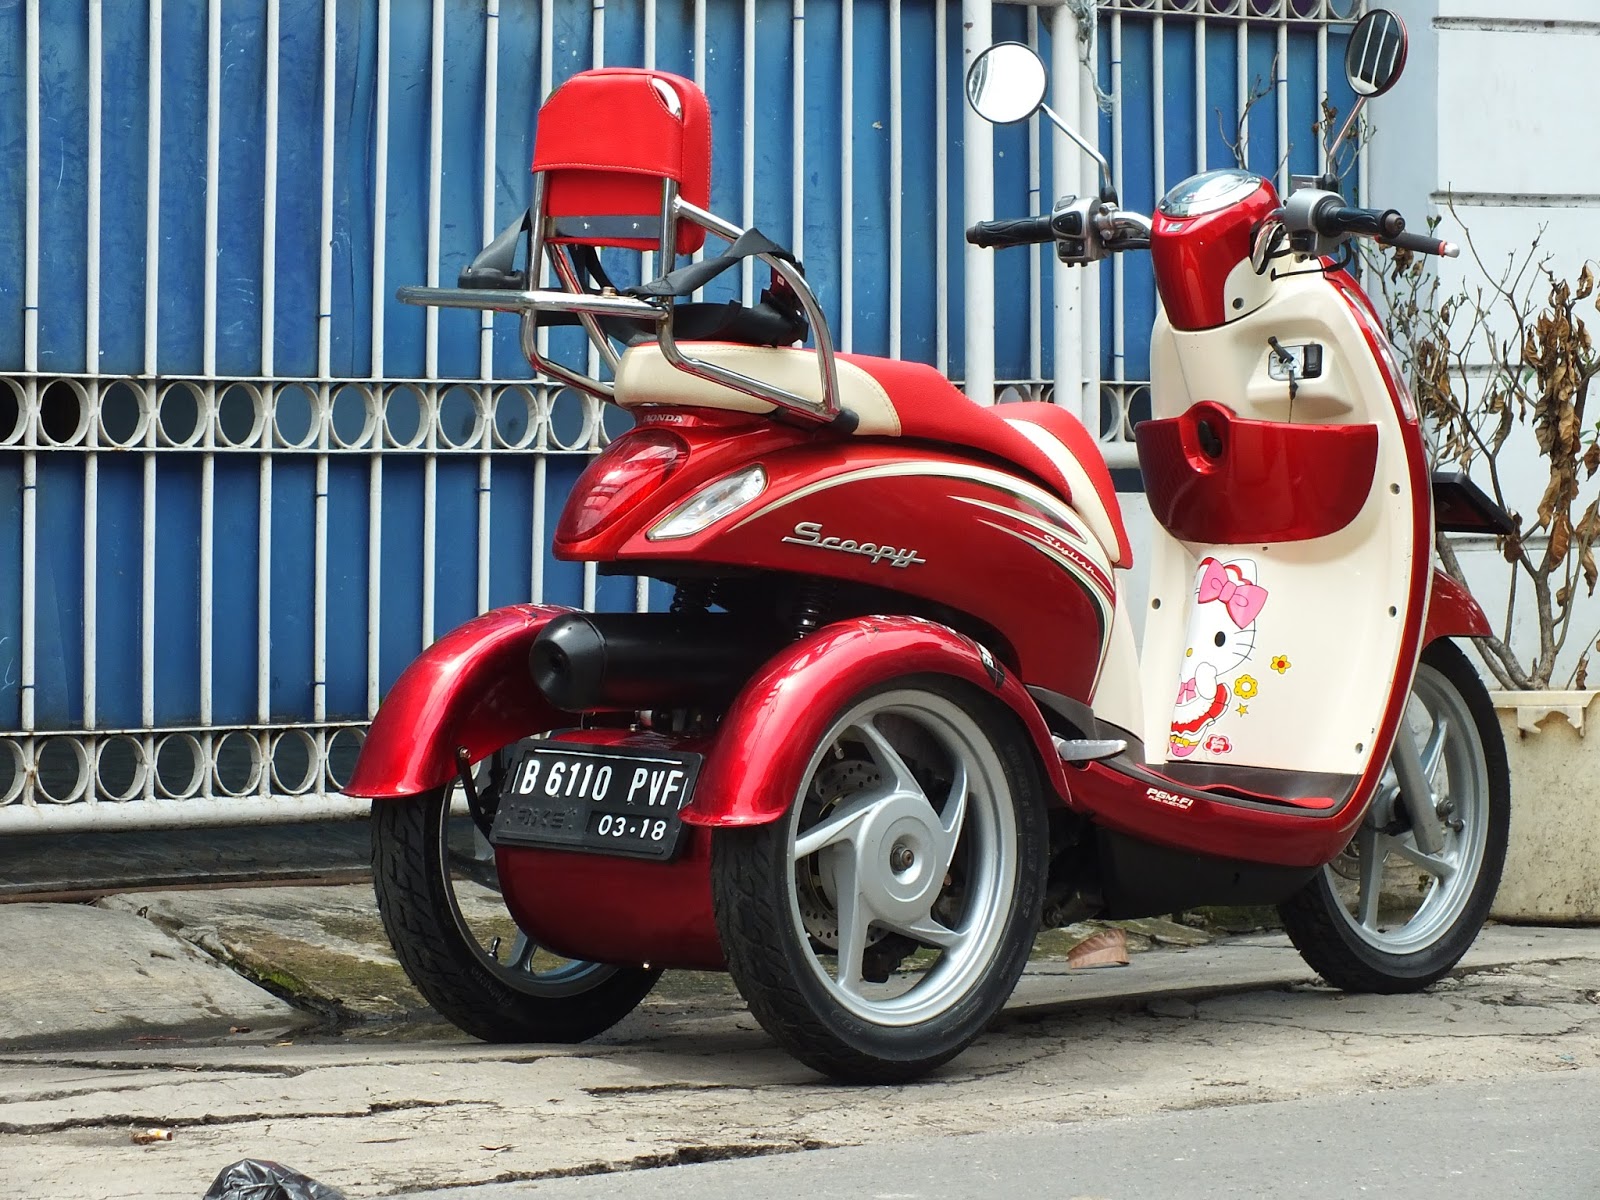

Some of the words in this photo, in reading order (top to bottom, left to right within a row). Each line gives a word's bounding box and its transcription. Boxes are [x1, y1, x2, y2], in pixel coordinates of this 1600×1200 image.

[643, 414, 683, 423] HONDA
[781, 521, 926, 568] Scoopy
[519, 759, 541, 795] B
[544, 761, 612, 801] 6110
[626, 767, 684, 806] PVF
